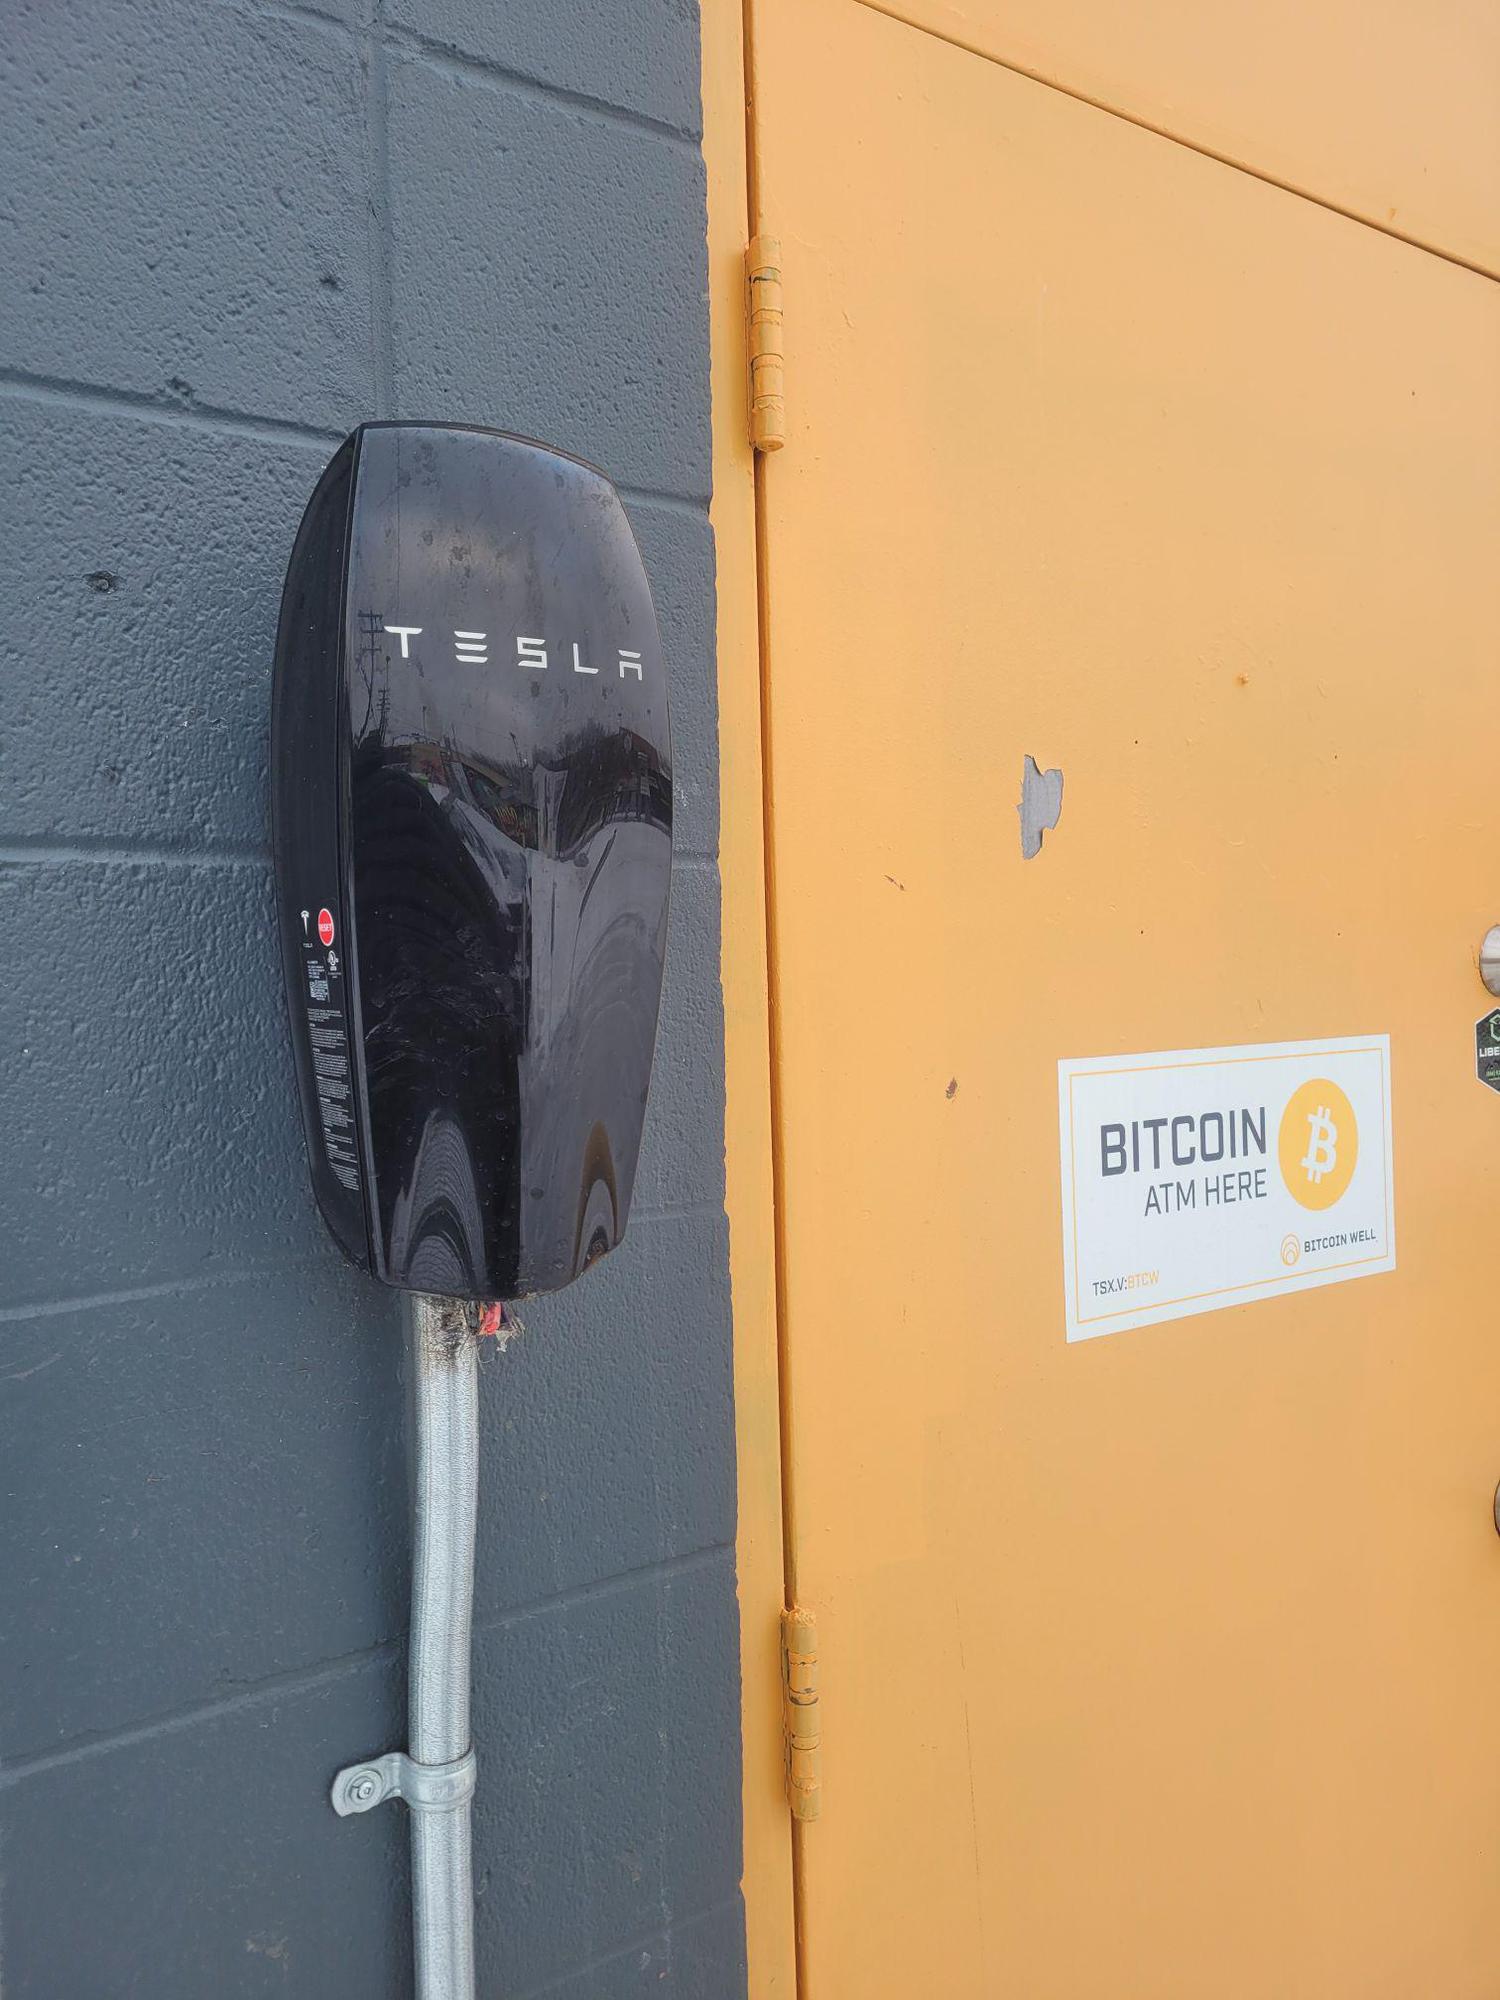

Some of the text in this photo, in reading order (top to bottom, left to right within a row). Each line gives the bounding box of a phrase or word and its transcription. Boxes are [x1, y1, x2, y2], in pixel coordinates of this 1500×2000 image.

[384, 625, 643, 681] TESLA
[1100, 1106, 1267, 1177] BITCOIN
[1144, 1168, 1268, 1217] ATM HERE
[1304, 1228, 1377, 1253] BITCOIN WELL
